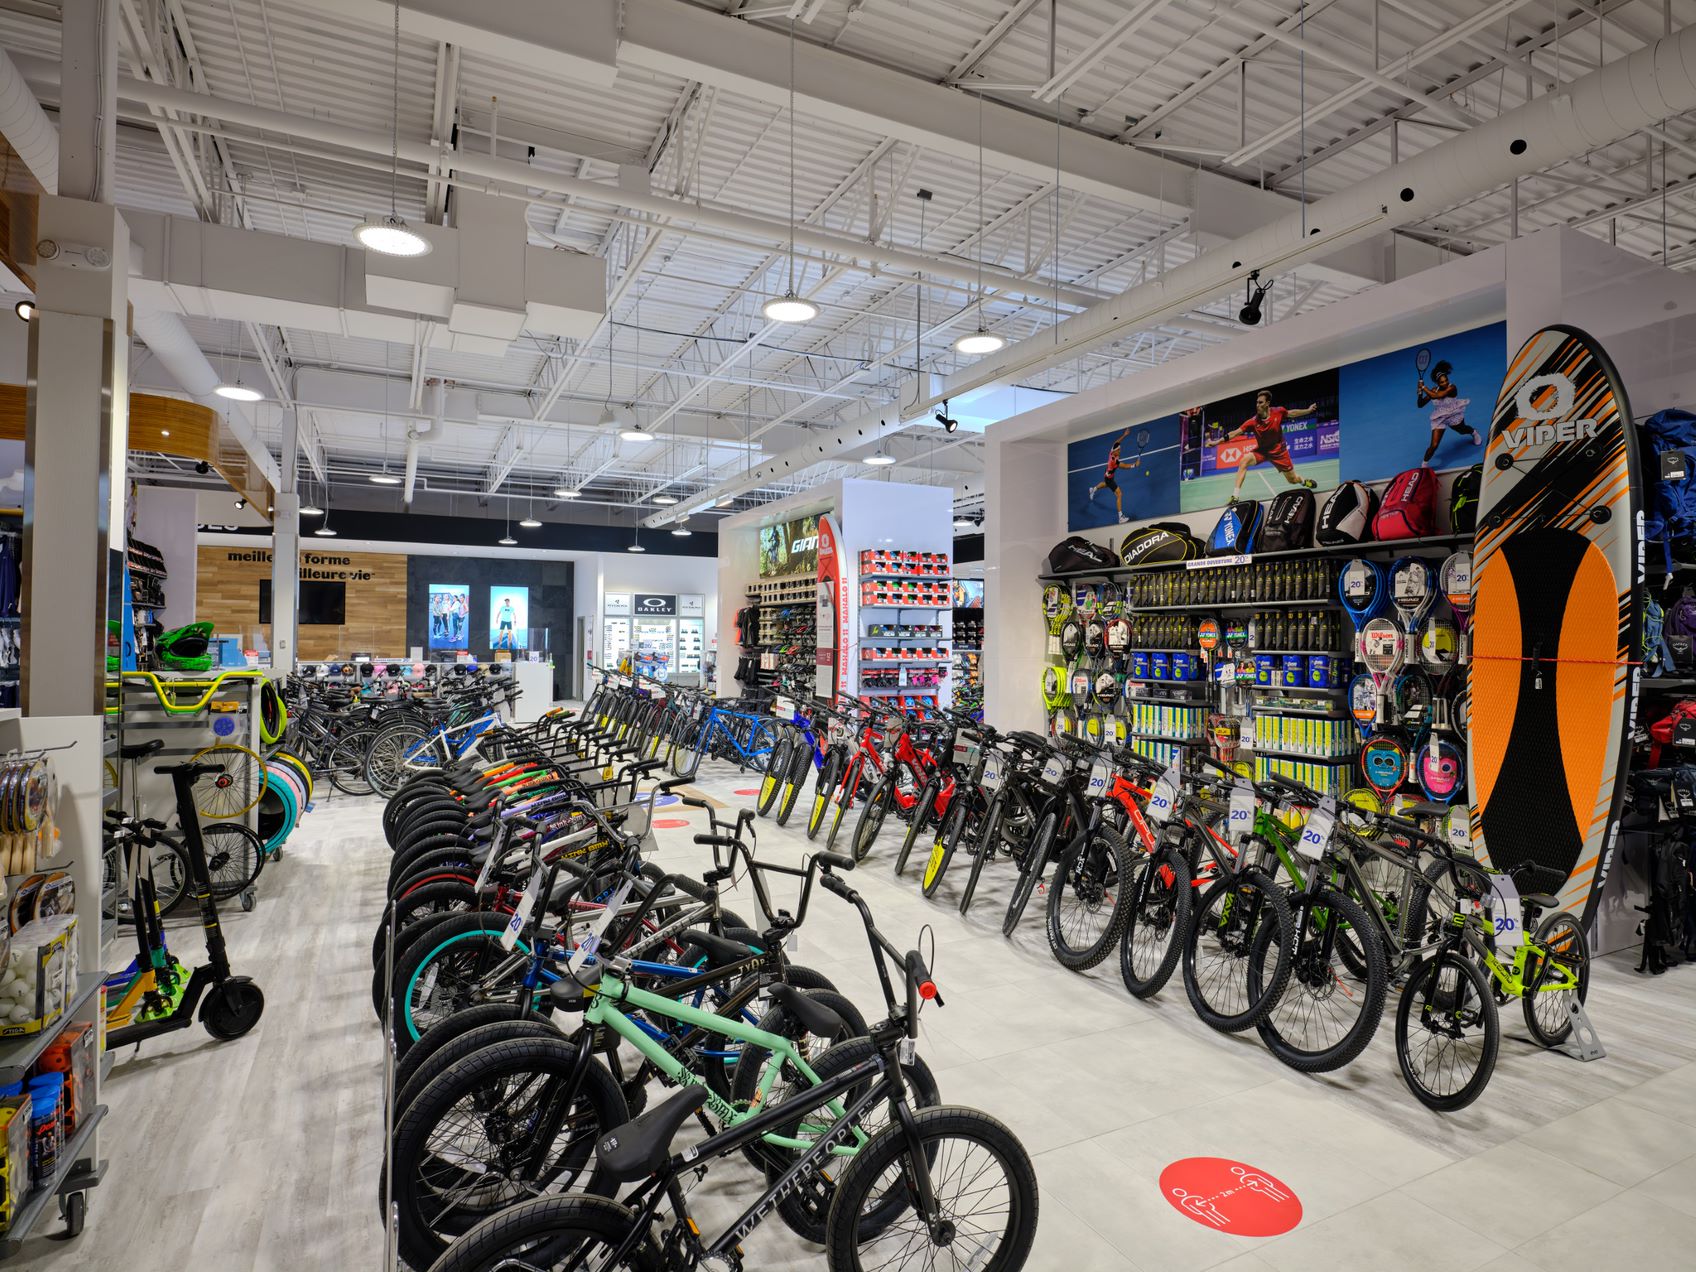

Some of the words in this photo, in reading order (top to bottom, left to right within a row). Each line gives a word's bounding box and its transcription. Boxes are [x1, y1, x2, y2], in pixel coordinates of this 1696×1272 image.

[1286, 421, 1308, 432] YONEX
[1502, 418, 1598, 449] VIPER
[1401, 472, 1419, 502] HEAD
[1284, 496, 1304, 524] HEAD
[791, 535, 819, 554] GIAN
[1123, 530, 1169, 565] DIADORA
[1636, 510, 1645, 584] VIPER
[299, 567, 346, 580] illeure
[304, 553, 350, 566] forme
[1187, 560, 1206, 568] GRANDE
[1206, 558, 1233, 566] OUVERTURE
[1371, 631, 1393, 640] Wilson
[841, 637, 849, 676] MAHALO
[1627, 666, 1640, 740] VIPER
[1133, 809, 1155, 848] OPU
[1597, 819, 1620, 888] VIPER
[1219, 1189, 1235, 1199] 2m
